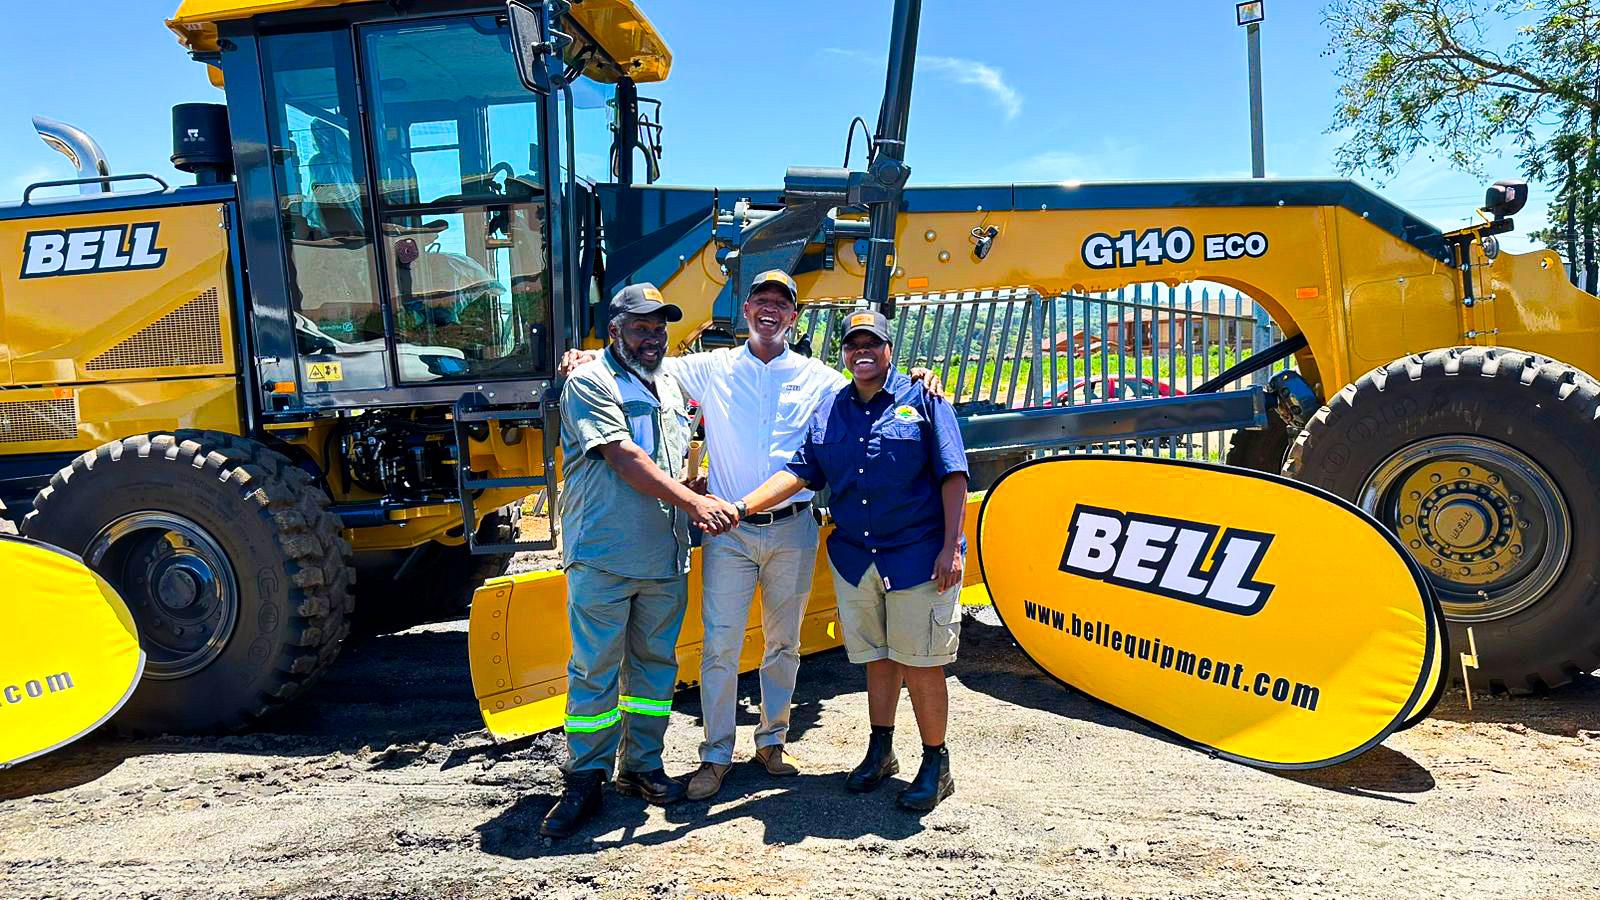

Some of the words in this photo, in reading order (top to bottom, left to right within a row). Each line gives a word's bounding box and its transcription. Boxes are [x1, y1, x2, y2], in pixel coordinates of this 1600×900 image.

[22, 224, 164, 277] BELL
[1083, 228, 1193, 267] G140
[1204, 233, 1266, 260] ECO
[1062, 508, 1270, 612] BELL
[1024, 599, 1321, 712] www.bellequipment.com
